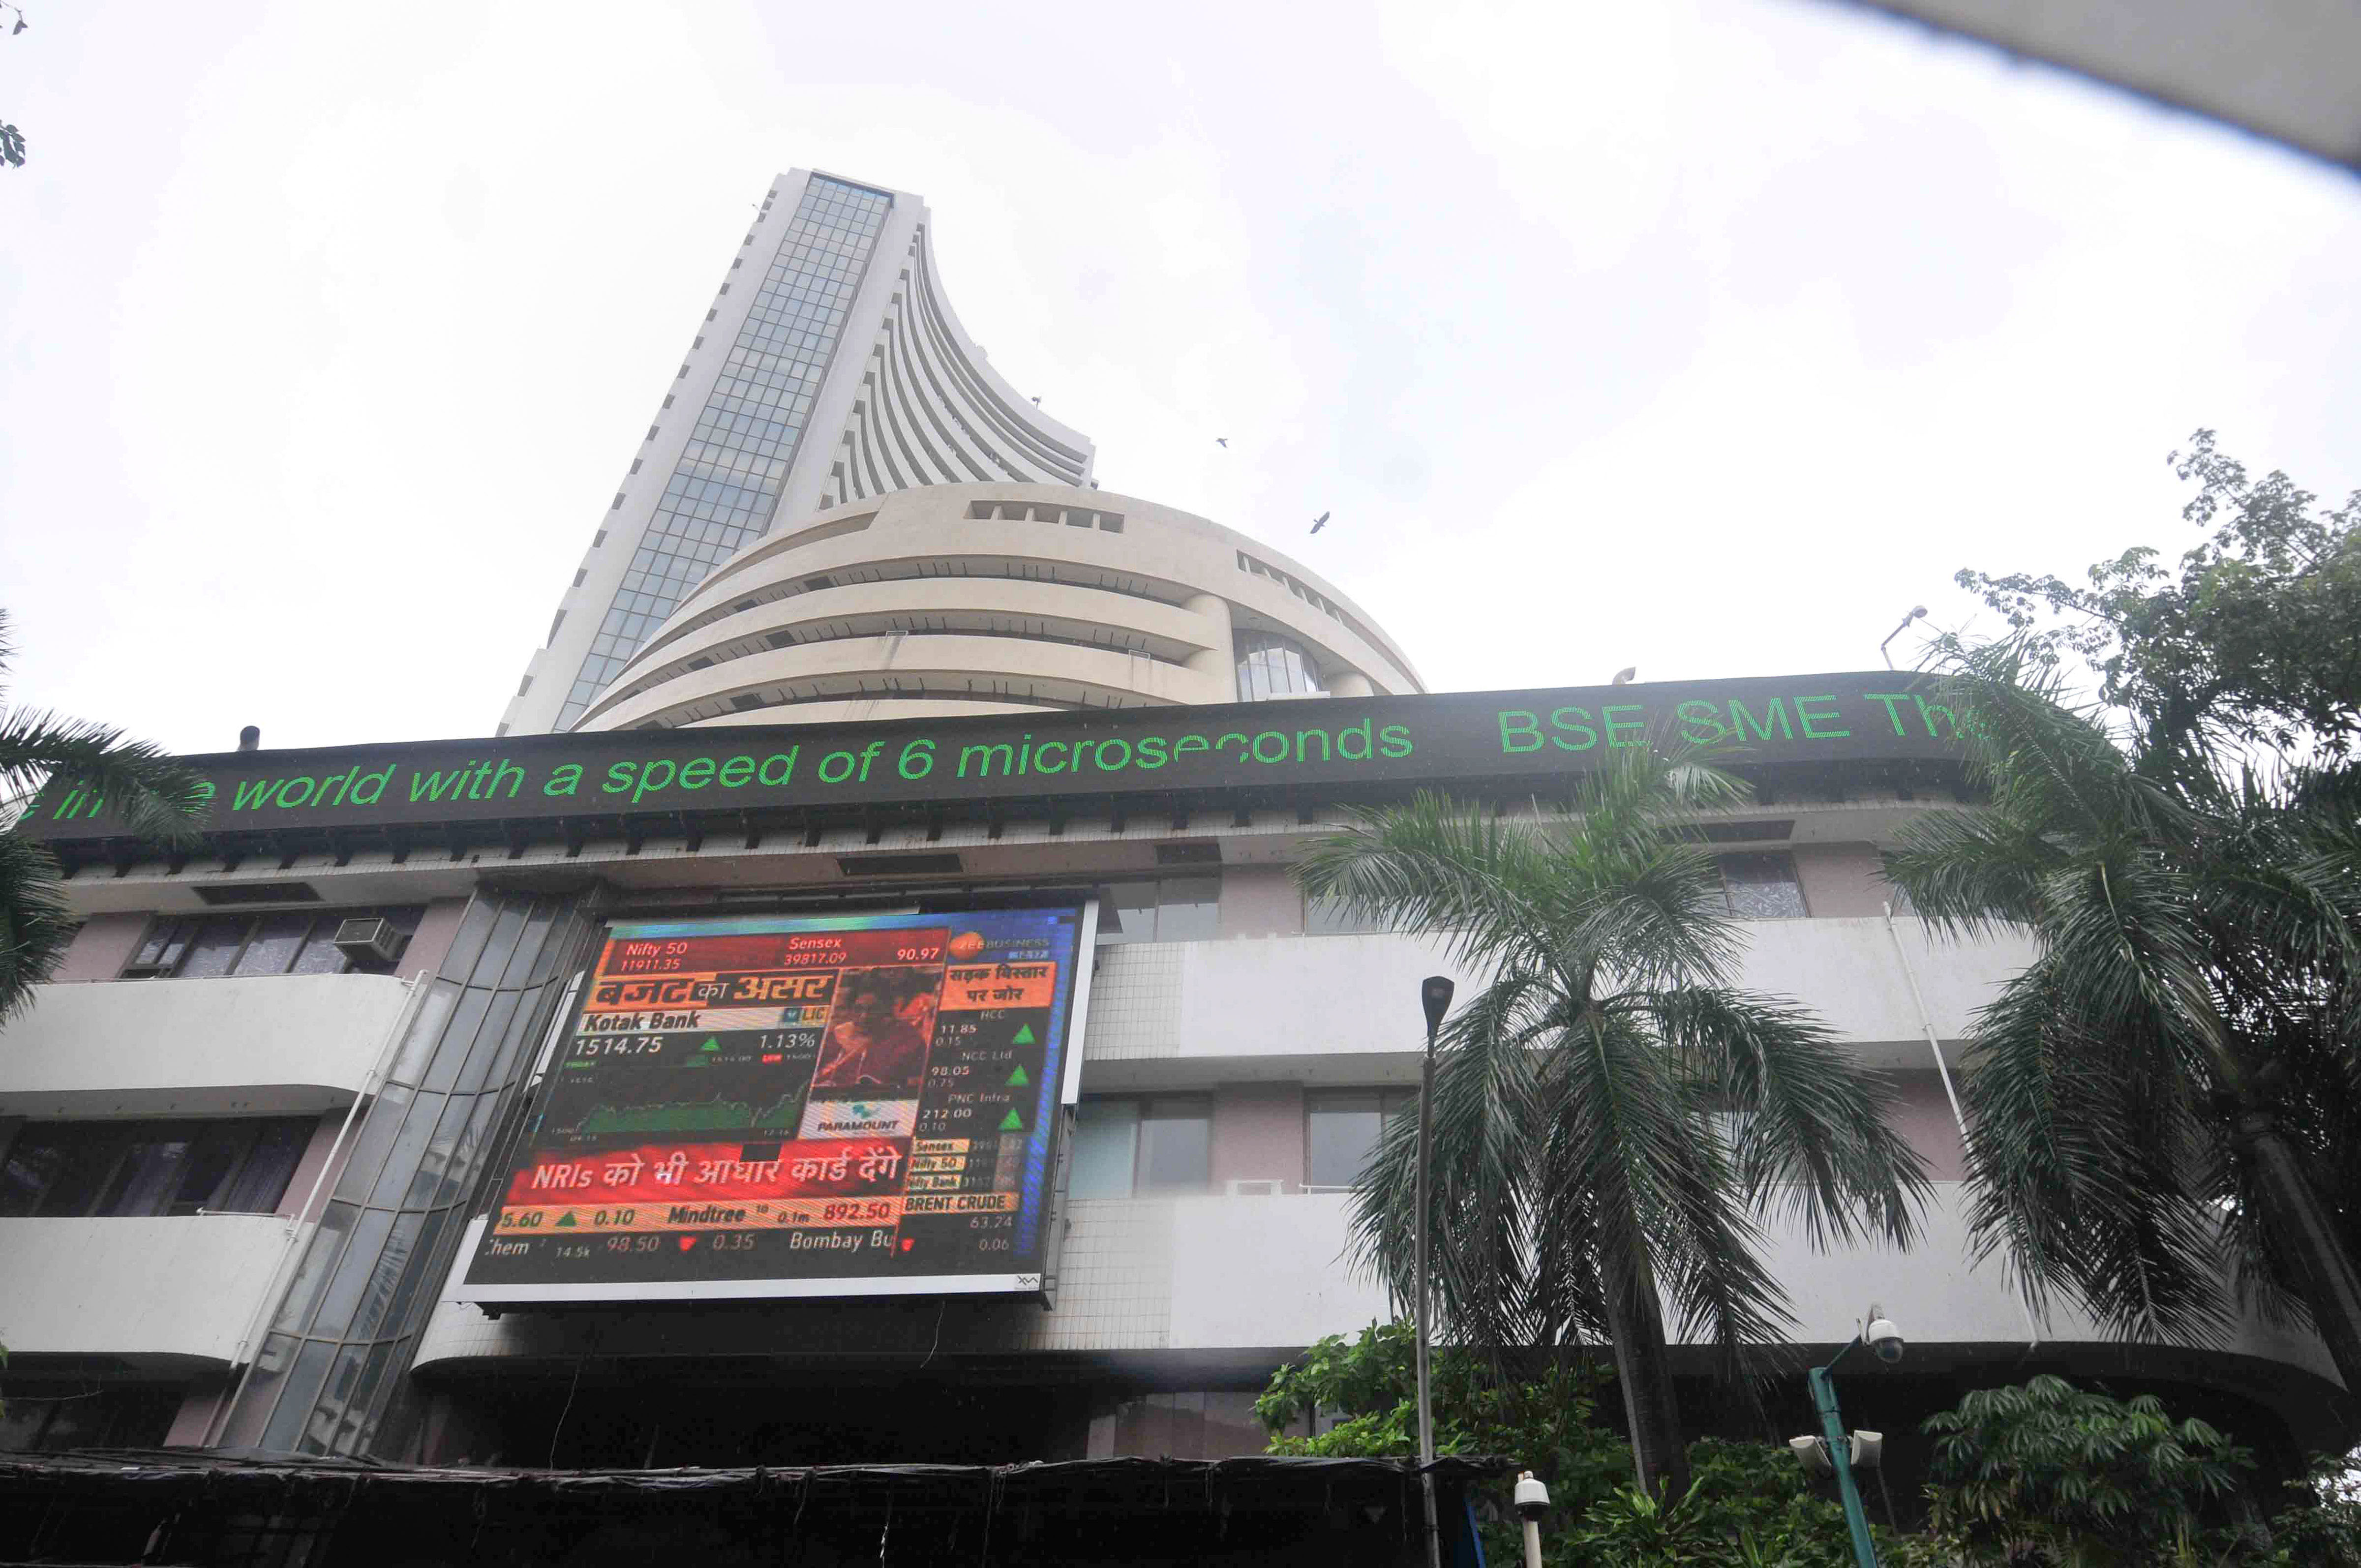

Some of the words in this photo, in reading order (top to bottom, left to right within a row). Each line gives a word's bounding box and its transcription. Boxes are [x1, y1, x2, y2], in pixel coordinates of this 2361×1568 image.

[233, 763, 397, 811] world
[409, 758, 526, 802] with
[542, 762, 584, 796] a
[602, 744, 800, 805] speed
[818, 740, 886, 784] of
[898, 739, 937, 780] 6
[1498, 704, 1649, 754] BSE
[1676, 694, 1851, 745] SME
[626, 941, 661, 958] Nifty
[665, 941, 688, 955] 50
[789, 936, 842, 951] Sensex
[784, 952, 847, 965] 39817.09
[897, 947, 939, 961] 90.97
[696, 983, 729, 999] का
[733, 975, 833, 1000] असर
[584, 1012, 642, 1032] Kotak
[648, 1011, 701, 1029] Bank
[575, 1036, 664, 1056] 1514.75
[759, 1032, 816, 1049] 1.13%
[817, 1120, 898, 1131] PARAMOUNT
[531, 1164, 594, 1189] NRIs
[603, 1153, 645, 1186] को
[653, 1150, 689, 1185] भी
[791, 1146, 854, 1181] कार्ड
[858, 1145, 902, 1183] देंगे
[905, 1197, 952, 1211] BRENT
[957, 1195, 1005, 1209] CRUDE
[593, 1210, 635, 1225] 0.10
[667, 1206, 746, 1223] Mindtree
[823, 1204, 891, 1220] 892.50
[789, 1230, 863, 1253] Bombay
